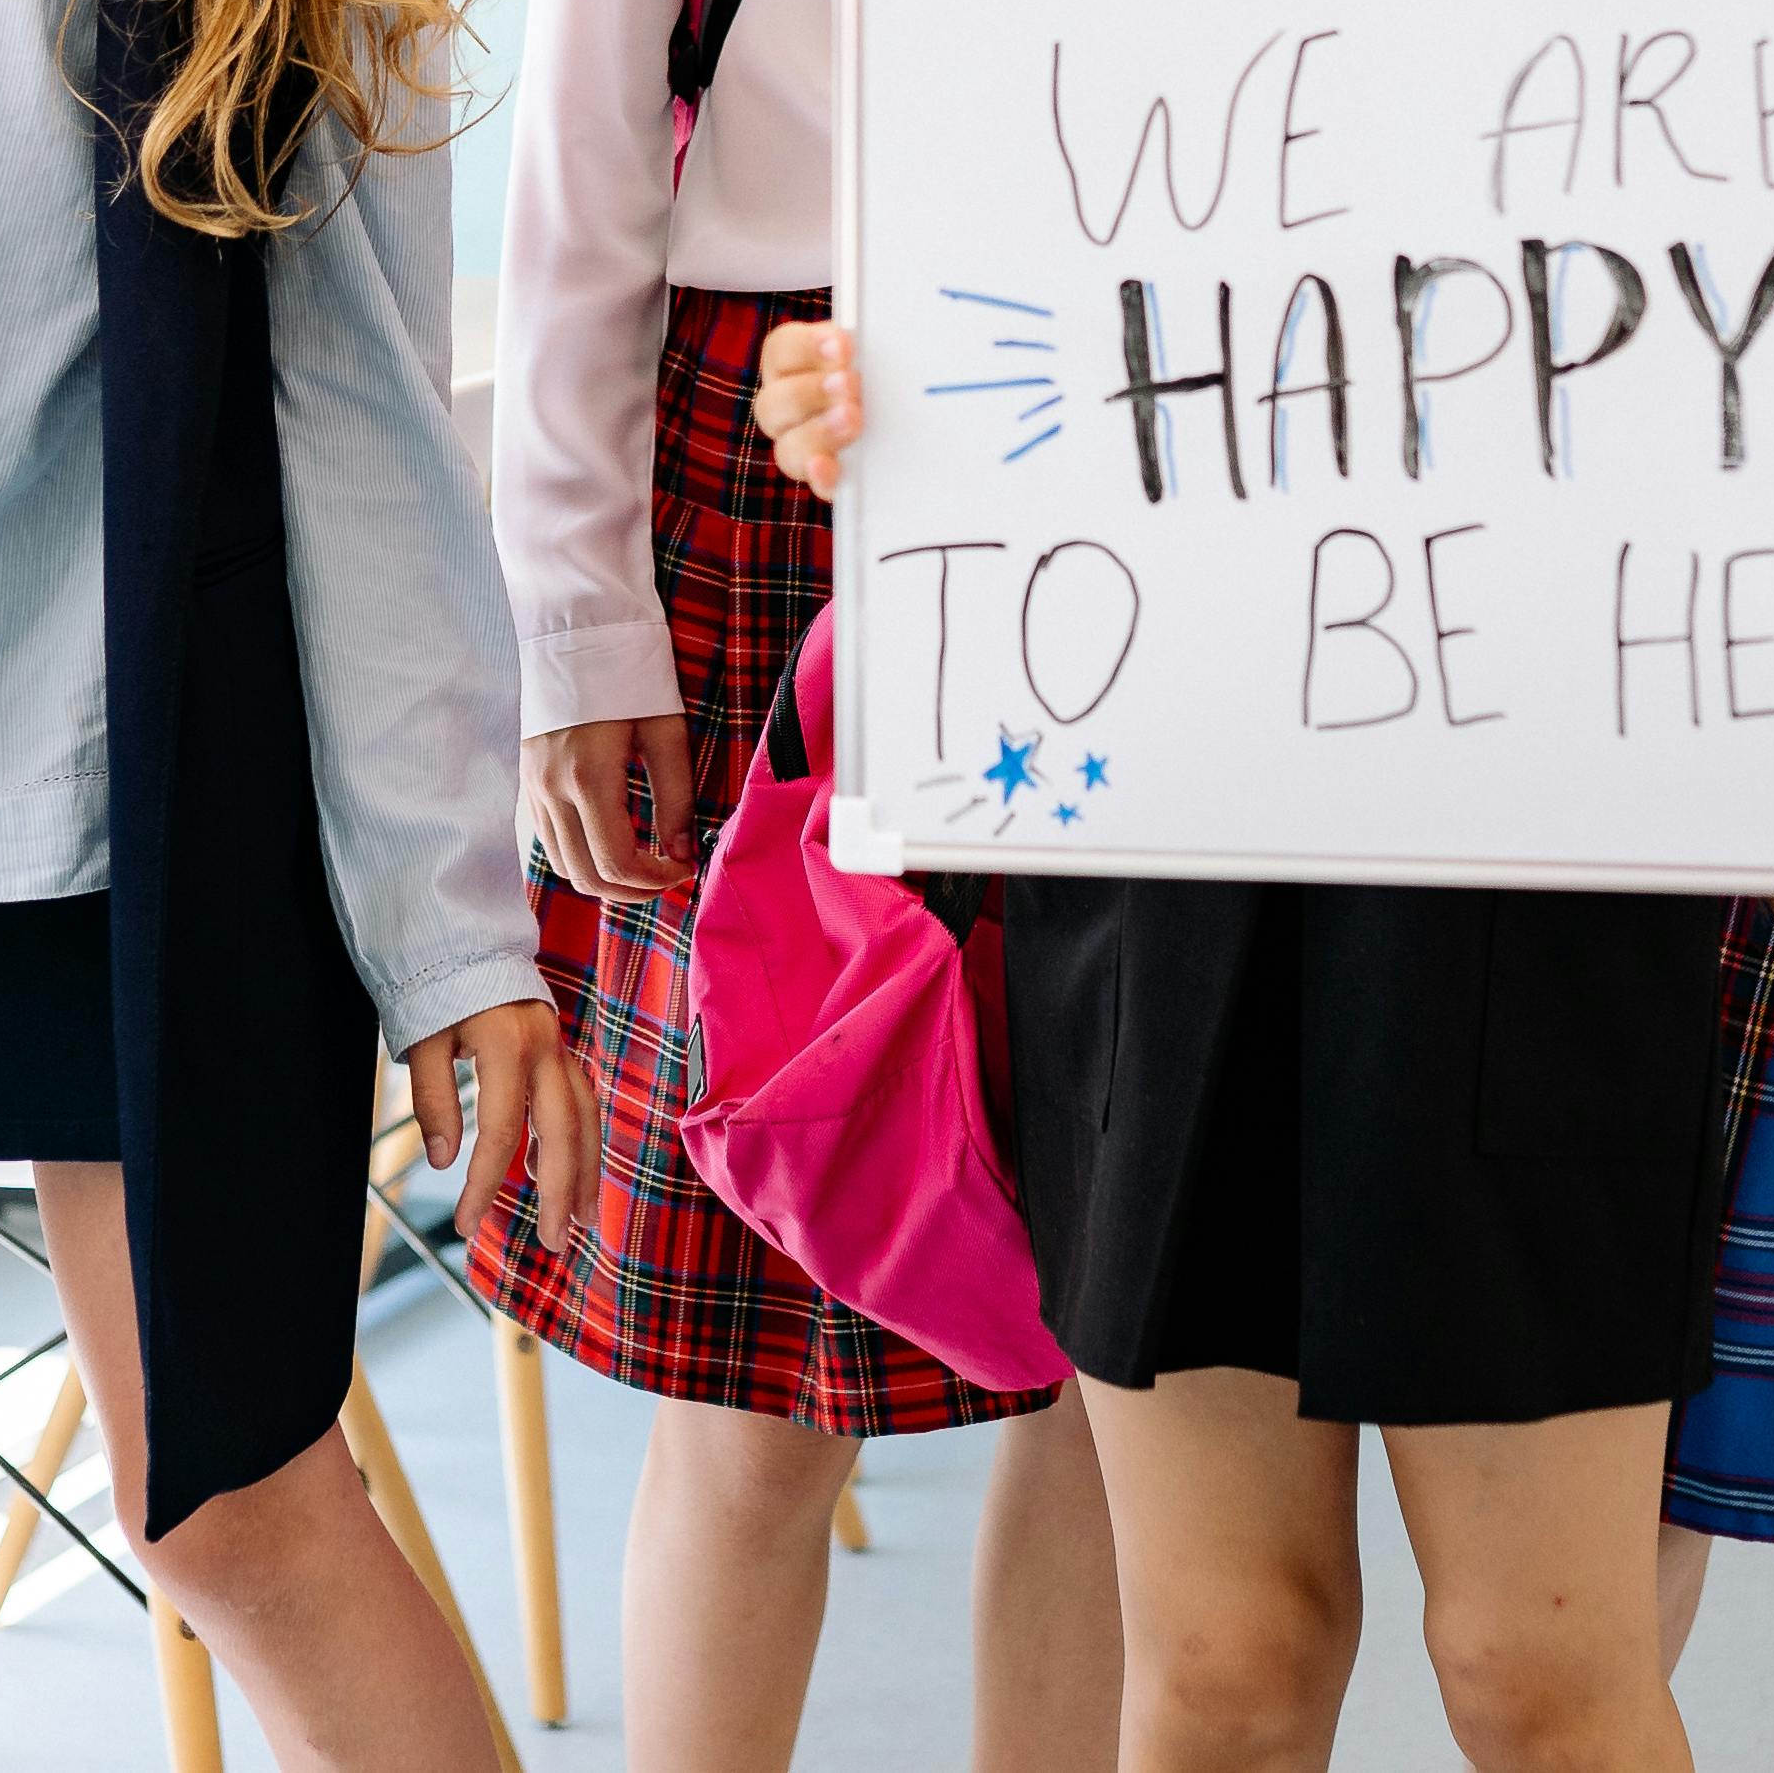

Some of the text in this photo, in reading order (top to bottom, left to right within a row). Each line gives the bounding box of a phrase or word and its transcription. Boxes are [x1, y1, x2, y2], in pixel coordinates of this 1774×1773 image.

[1053, 28, 1350, 247] WE
[879, 539, 1141, 761] TO
[1301, 524, 1507, 731] BE
